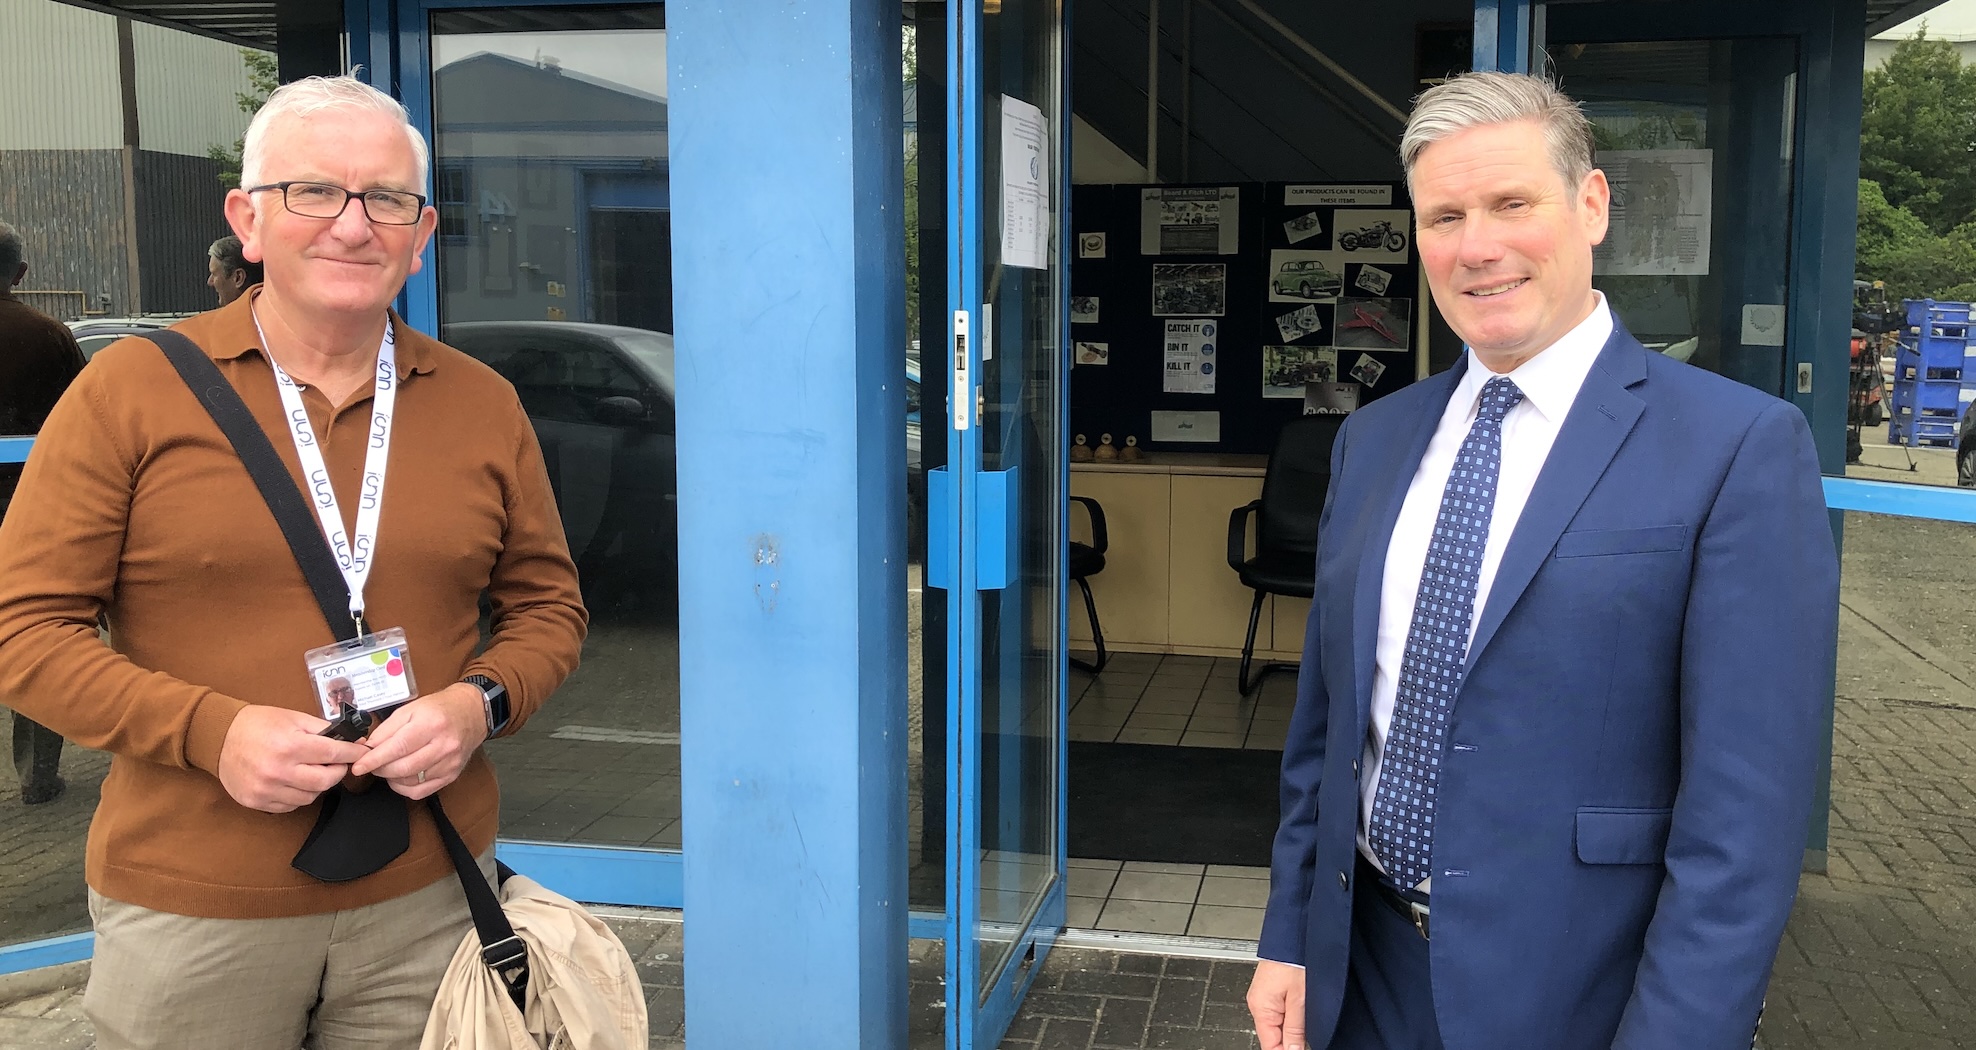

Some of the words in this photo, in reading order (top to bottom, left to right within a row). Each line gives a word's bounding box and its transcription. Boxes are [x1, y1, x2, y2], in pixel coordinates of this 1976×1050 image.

[1167, 324, 1191, 333] CATCH
[1193, 324, 1200, 333] IT
[1167, 343, 1180, 351] BIN
[1181, 343, 1189, 351] IT
[1166, 362, 1182, 370] KILL
[1183, 362, 1191, 370] IT
